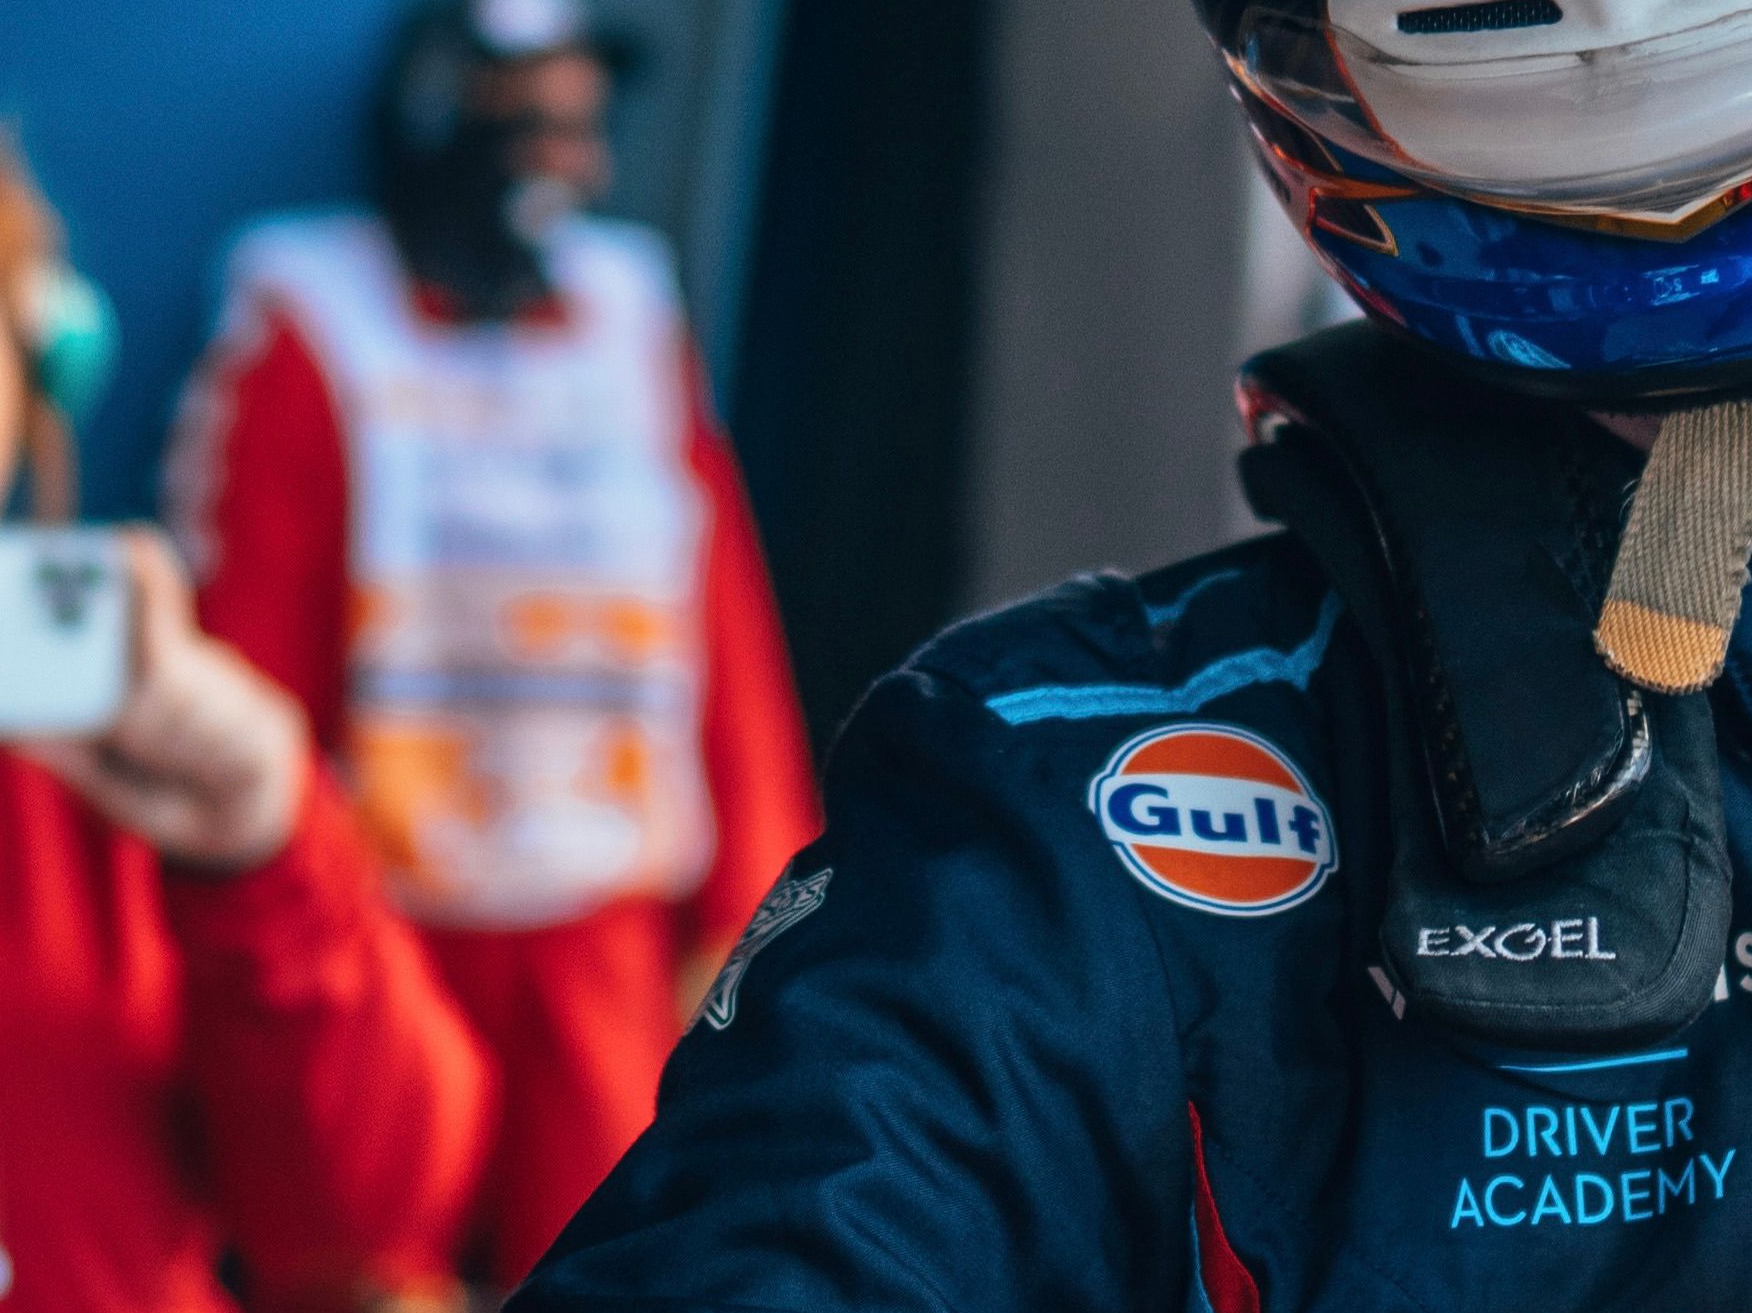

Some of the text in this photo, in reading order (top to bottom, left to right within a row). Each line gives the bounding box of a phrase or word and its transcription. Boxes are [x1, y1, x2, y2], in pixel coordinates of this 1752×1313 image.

[1107, 782, 1321, 855] Gulf
[1416, 916, 1616, 961] EXGEL
[1483, 1096, 1694, 1158] DRIVER
[1451, 1149, 1737, 1229] ACADEMY
